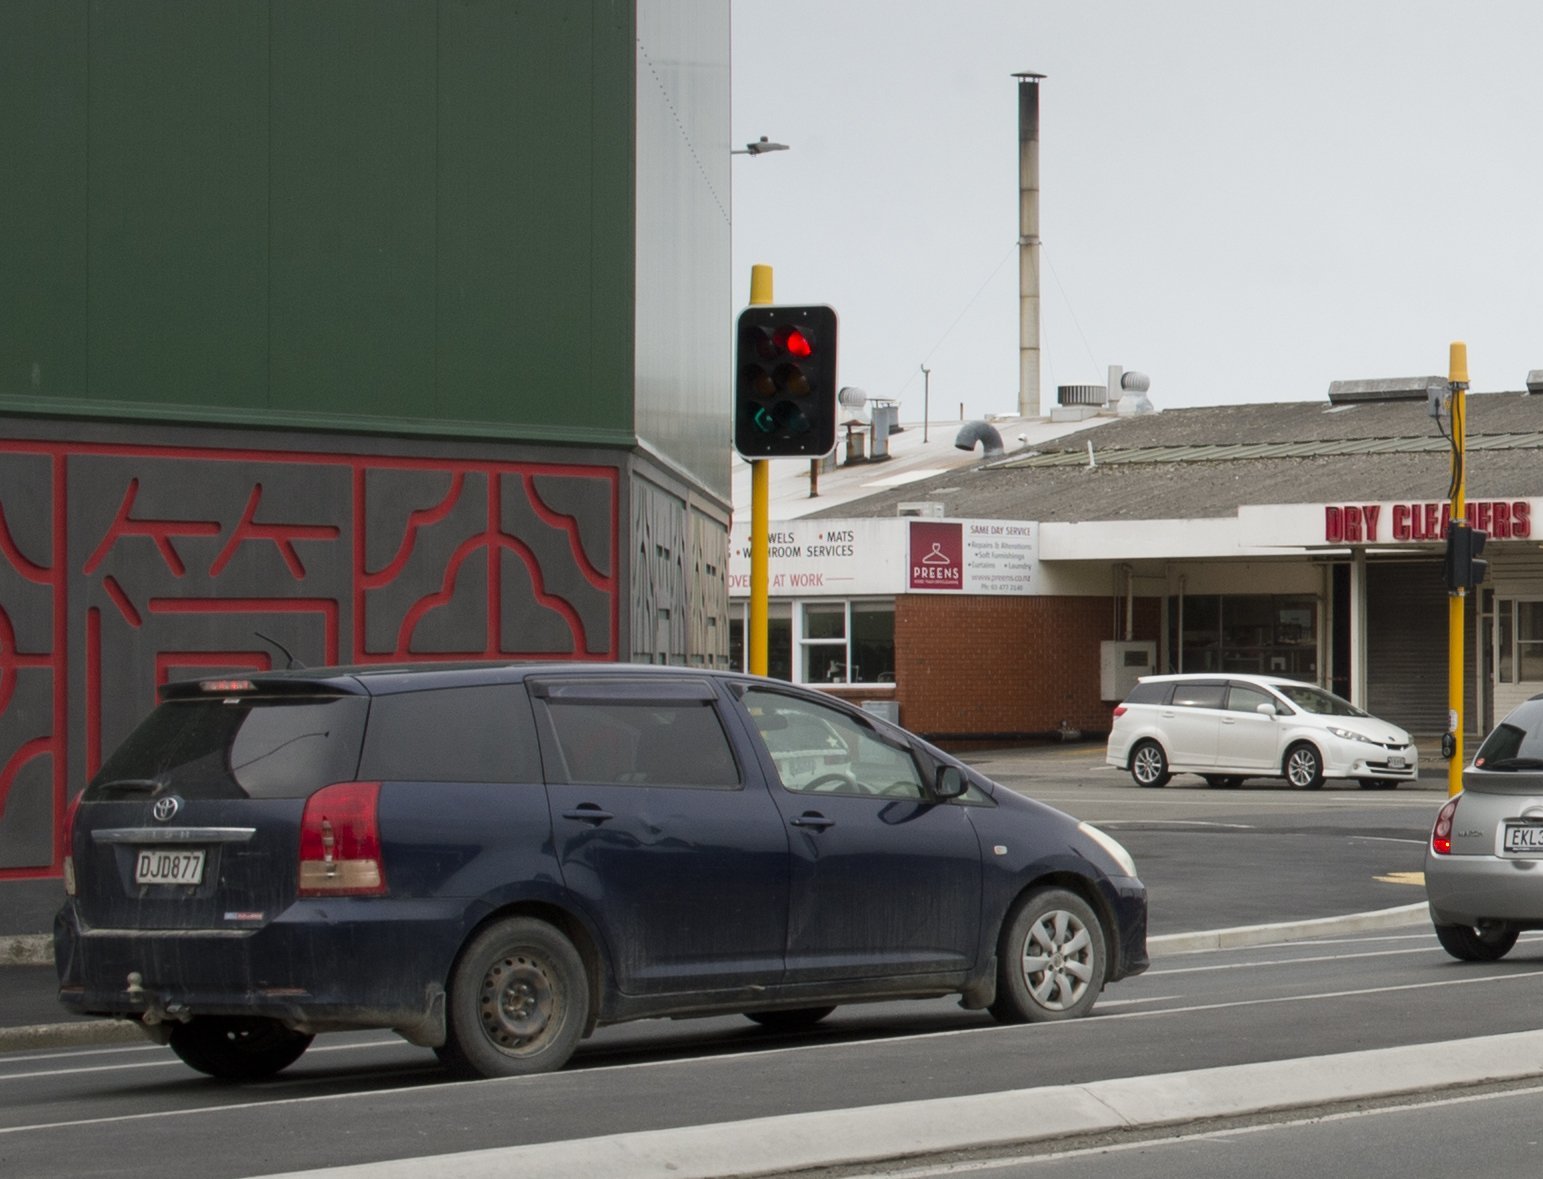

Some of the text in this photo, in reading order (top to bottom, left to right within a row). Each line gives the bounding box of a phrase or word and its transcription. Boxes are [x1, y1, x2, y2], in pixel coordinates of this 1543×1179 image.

[970, 525, 1031, 536] SAME DAY SERVICE
[1325, 506, 1380, 542] DRY
[767, 531, 854, 544] WELS MATS
[743, 547, 801, 558] WHROOM
[807, 545, 854, 557] SERVICES
[913, 567, 959, 579] PREENS
[773, 575, 785, 587] AT
[790, 573, 824, 587] WORK
[139, 855, 200, 879] DJD877
